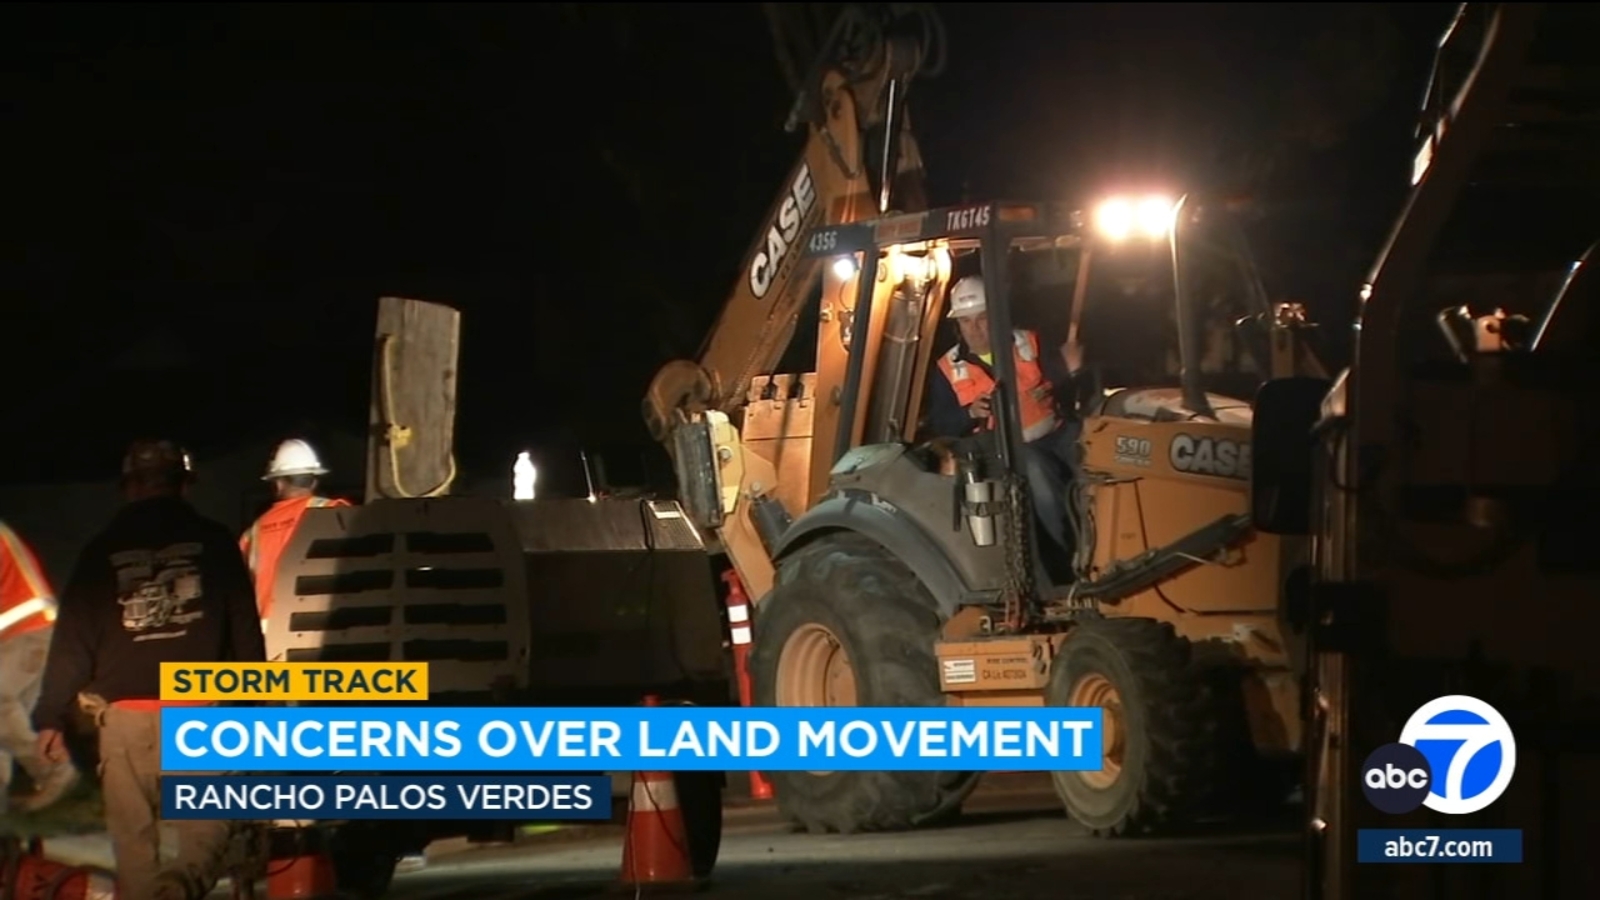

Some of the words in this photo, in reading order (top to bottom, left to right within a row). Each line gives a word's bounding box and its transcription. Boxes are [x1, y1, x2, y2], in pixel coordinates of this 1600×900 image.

[749, 162, 817, 299] CASE
[809, 230, 837, 252] 4356
[1115, 436, 1151, 456] 590
[1171, 433, 1253, 478] CASE
